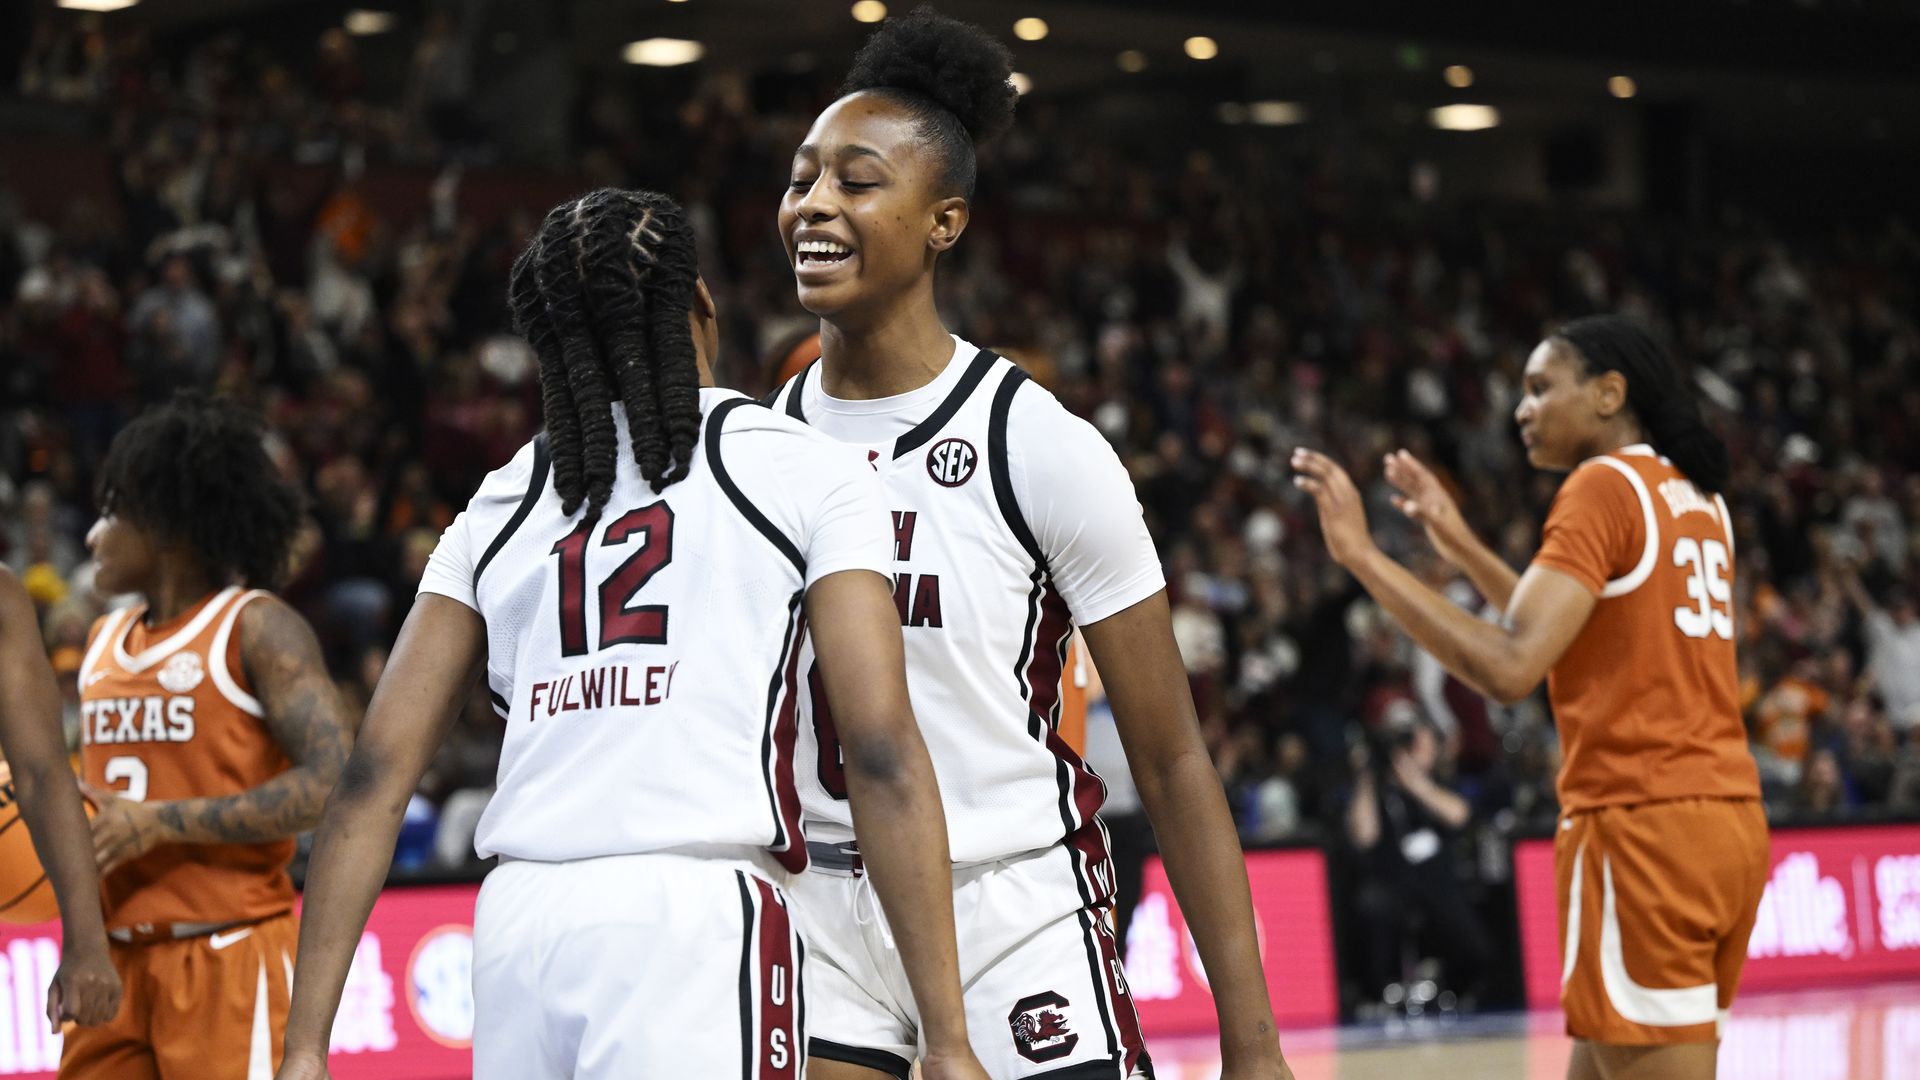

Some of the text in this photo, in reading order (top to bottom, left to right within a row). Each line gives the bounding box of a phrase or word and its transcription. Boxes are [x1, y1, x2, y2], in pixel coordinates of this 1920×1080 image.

[931, 441, 974, 483] SEC
[549, 499, 675, 658] 12
[1672, 536, 1734, 640] 35
[81, 695, 196, 745] TEXAS
[530, 660, 680, 722] FULWILEY
